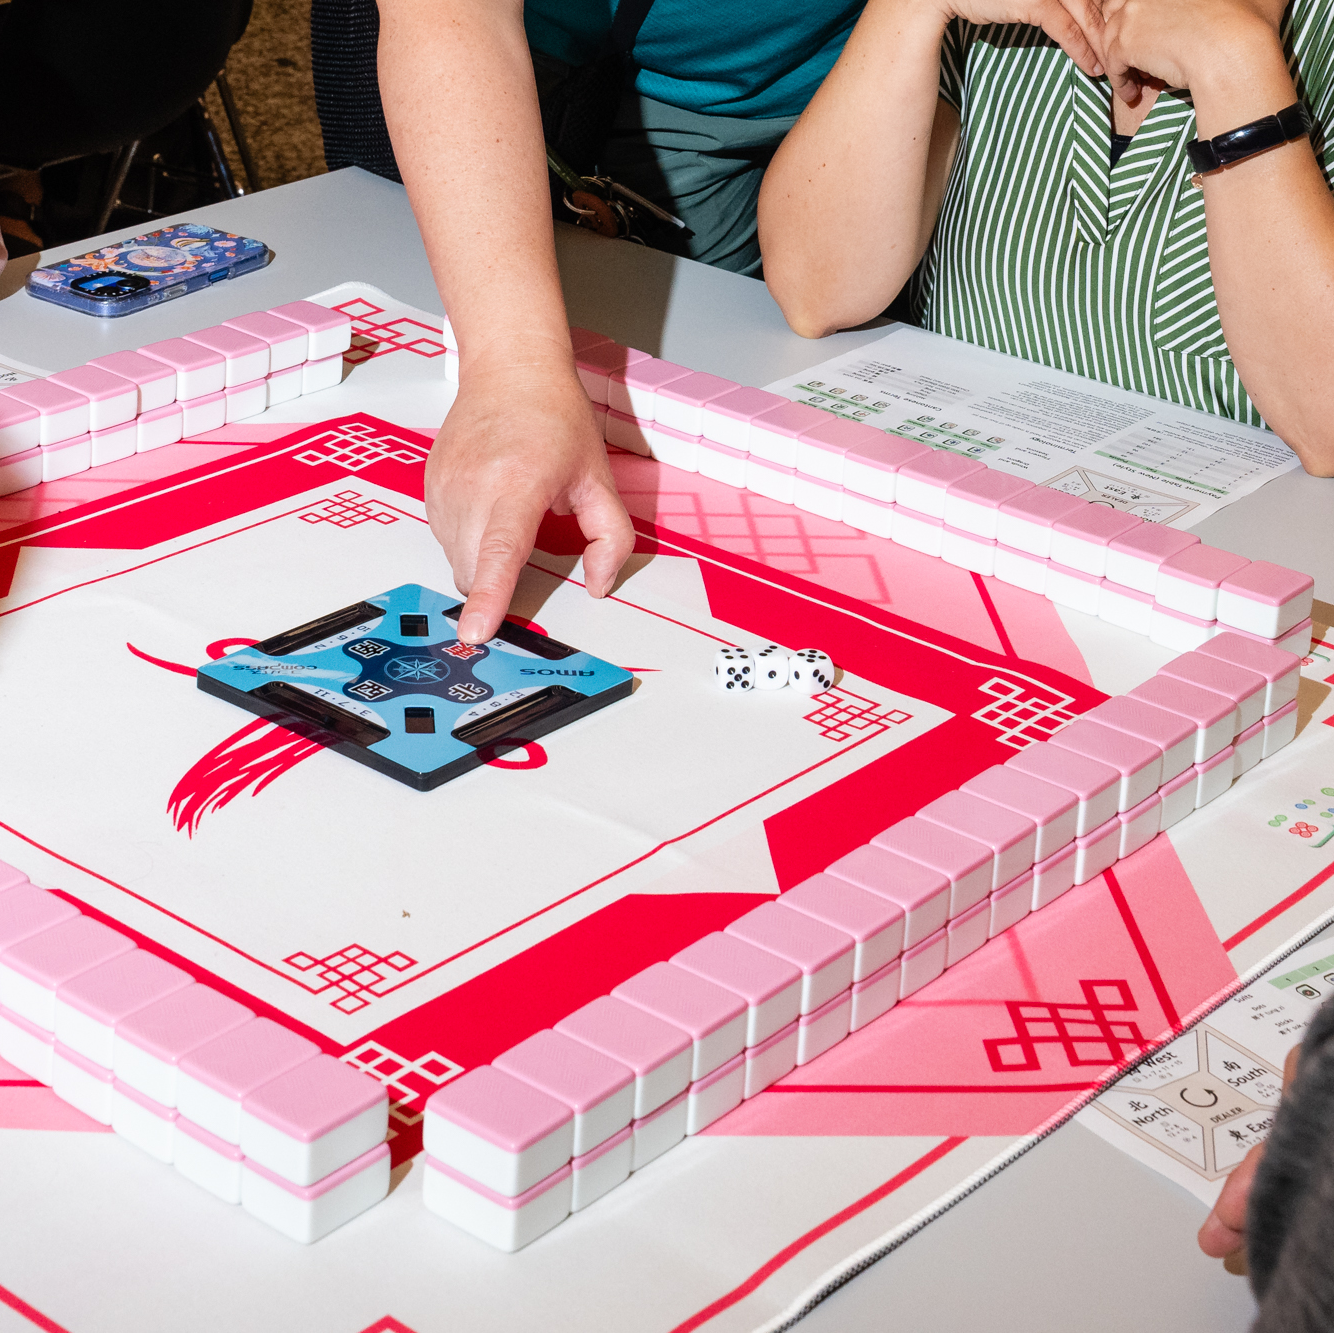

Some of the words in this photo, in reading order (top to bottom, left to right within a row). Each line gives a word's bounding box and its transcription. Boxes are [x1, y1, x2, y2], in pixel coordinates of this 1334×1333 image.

[880, 390, 901, 399] Terms
[904, 398, 942, 411] Cantonese
[1030, 437, 1076, 453] Terminology
[1113, 463, 1136, 472] Style)
[1161, 479, 1182, 487] Table
[1103, 484, 1127, 497] East
[1185, 486, 1221, 499] Payment
[1100, 493, 1128, 505] DEALER
[356, 624, 372, 633] 10
[336, 633, 348, 641] 6
[314, 643, 327, 651] 2
[348, 639, 391, 660] 南
[494, 640, 506, 648] 5
[441, 641, 484, 661] 東
[313, 688, 331, 698] 11
[347, 679, 393, 701] 西
[447, 682, 488, 702] 北
[509, 690, 526, 700] 12
[490, 700, 502, 708] 8
[359, 708, 372, 717] 3
[467, 710, 479, 718] 4
[1233, 993, 1254, 1004] Suits
[1251, 1003, 1267, 1012] Dots
[1274, 1017, 1294, 1028] Sticks
[1144, 1050, 1178, 1072] West
[1227, 1066, 1268, 1088] South
[1127, 1099, 1149, 1112] 北
[1131, 1106, 1174, 1127] North
[1209, 1106, 1245, 1124] DEALER
[1245, 1117, 1274, 1134] Eas
